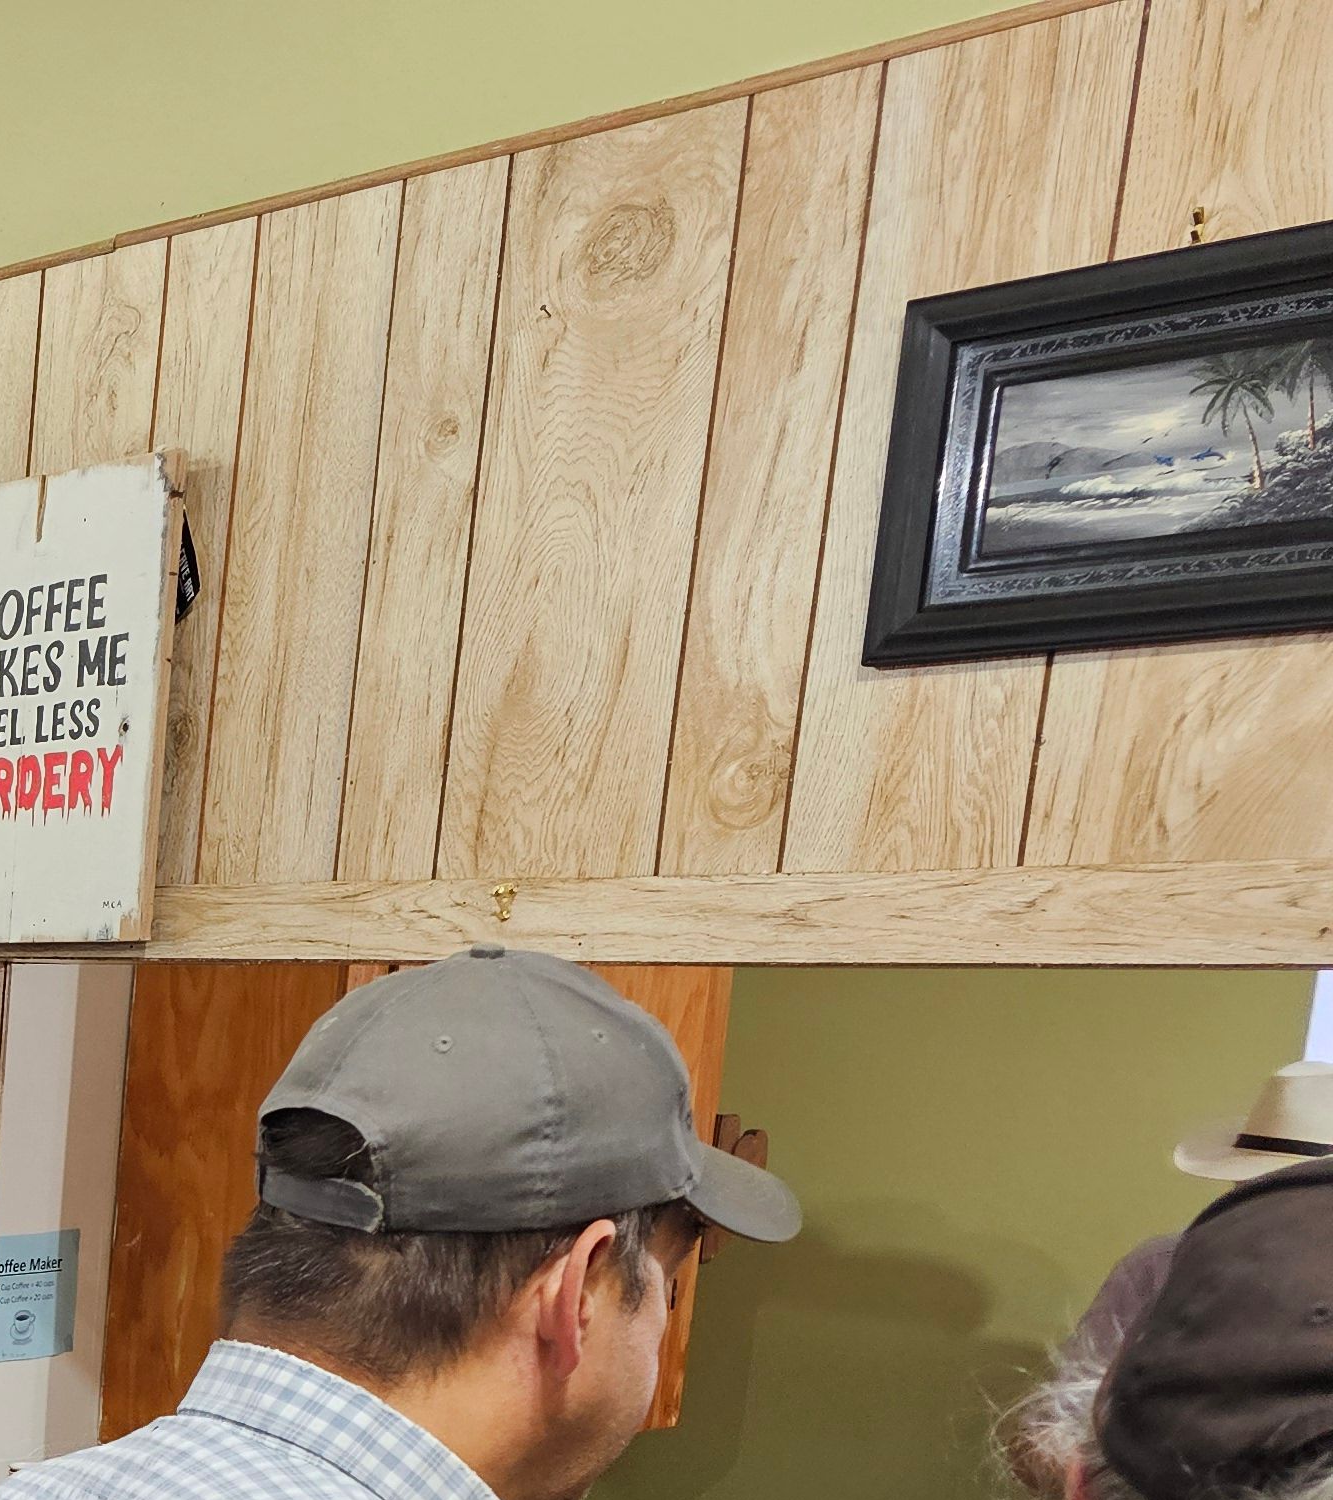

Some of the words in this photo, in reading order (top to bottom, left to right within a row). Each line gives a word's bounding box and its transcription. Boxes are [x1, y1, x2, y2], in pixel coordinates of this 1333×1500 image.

[76, 632, 129, 687] ME
[35, 698, 101, 743] LESS
[29, 1255, 63, 1271] Maker
[12, 1281, 30, 1290] Coffee
[12, 1294, 29, 1303] Coffee
